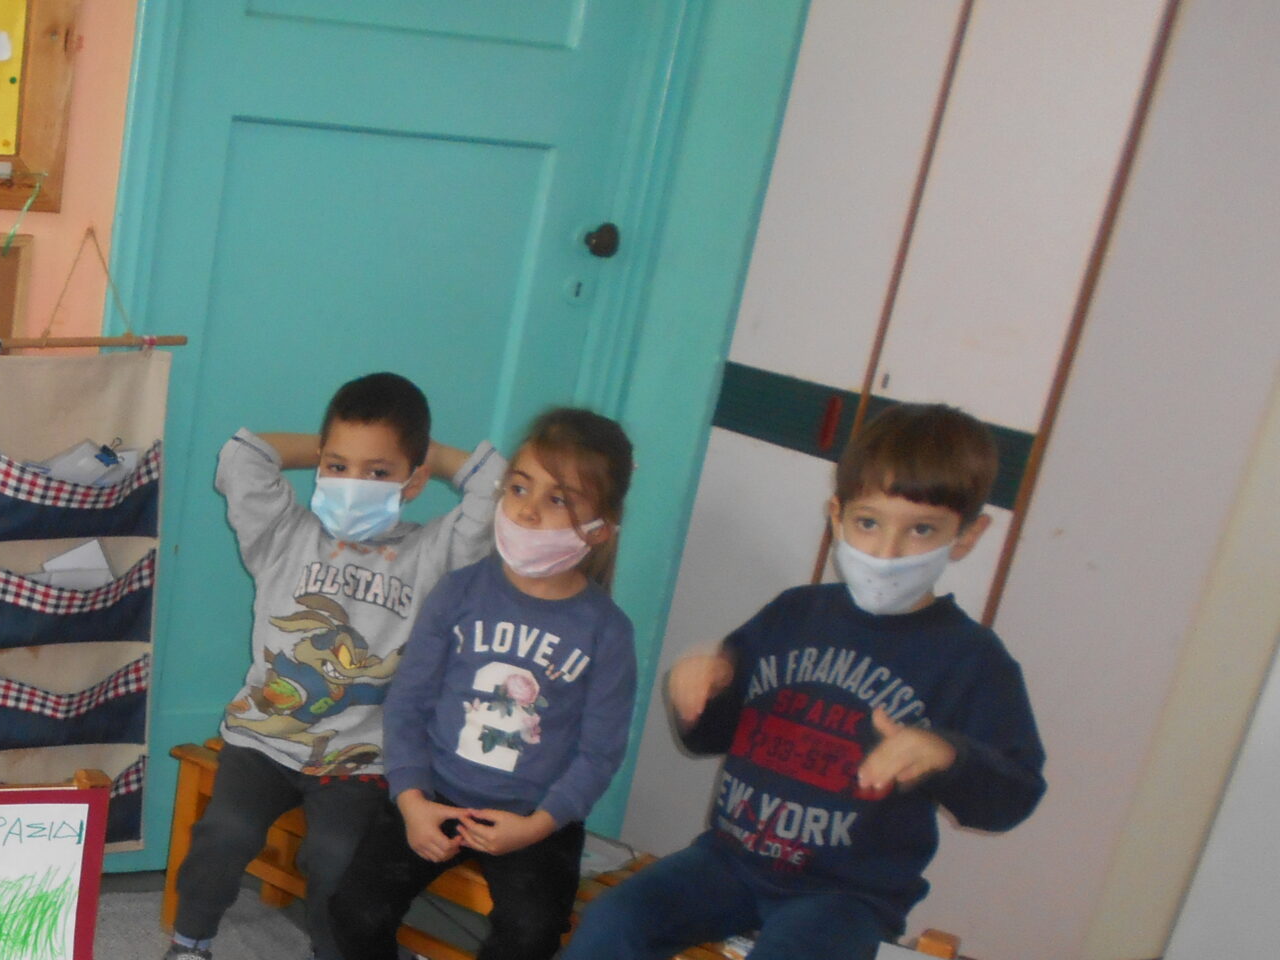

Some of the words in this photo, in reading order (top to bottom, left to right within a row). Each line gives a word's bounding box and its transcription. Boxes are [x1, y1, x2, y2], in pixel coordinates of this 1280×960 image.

[293, 562, 342, 598] ALL
[342, 564, 413, 619] STARS
[474, 620, 561, 667] LOVE
[758, 793, 858, 847] YORK
